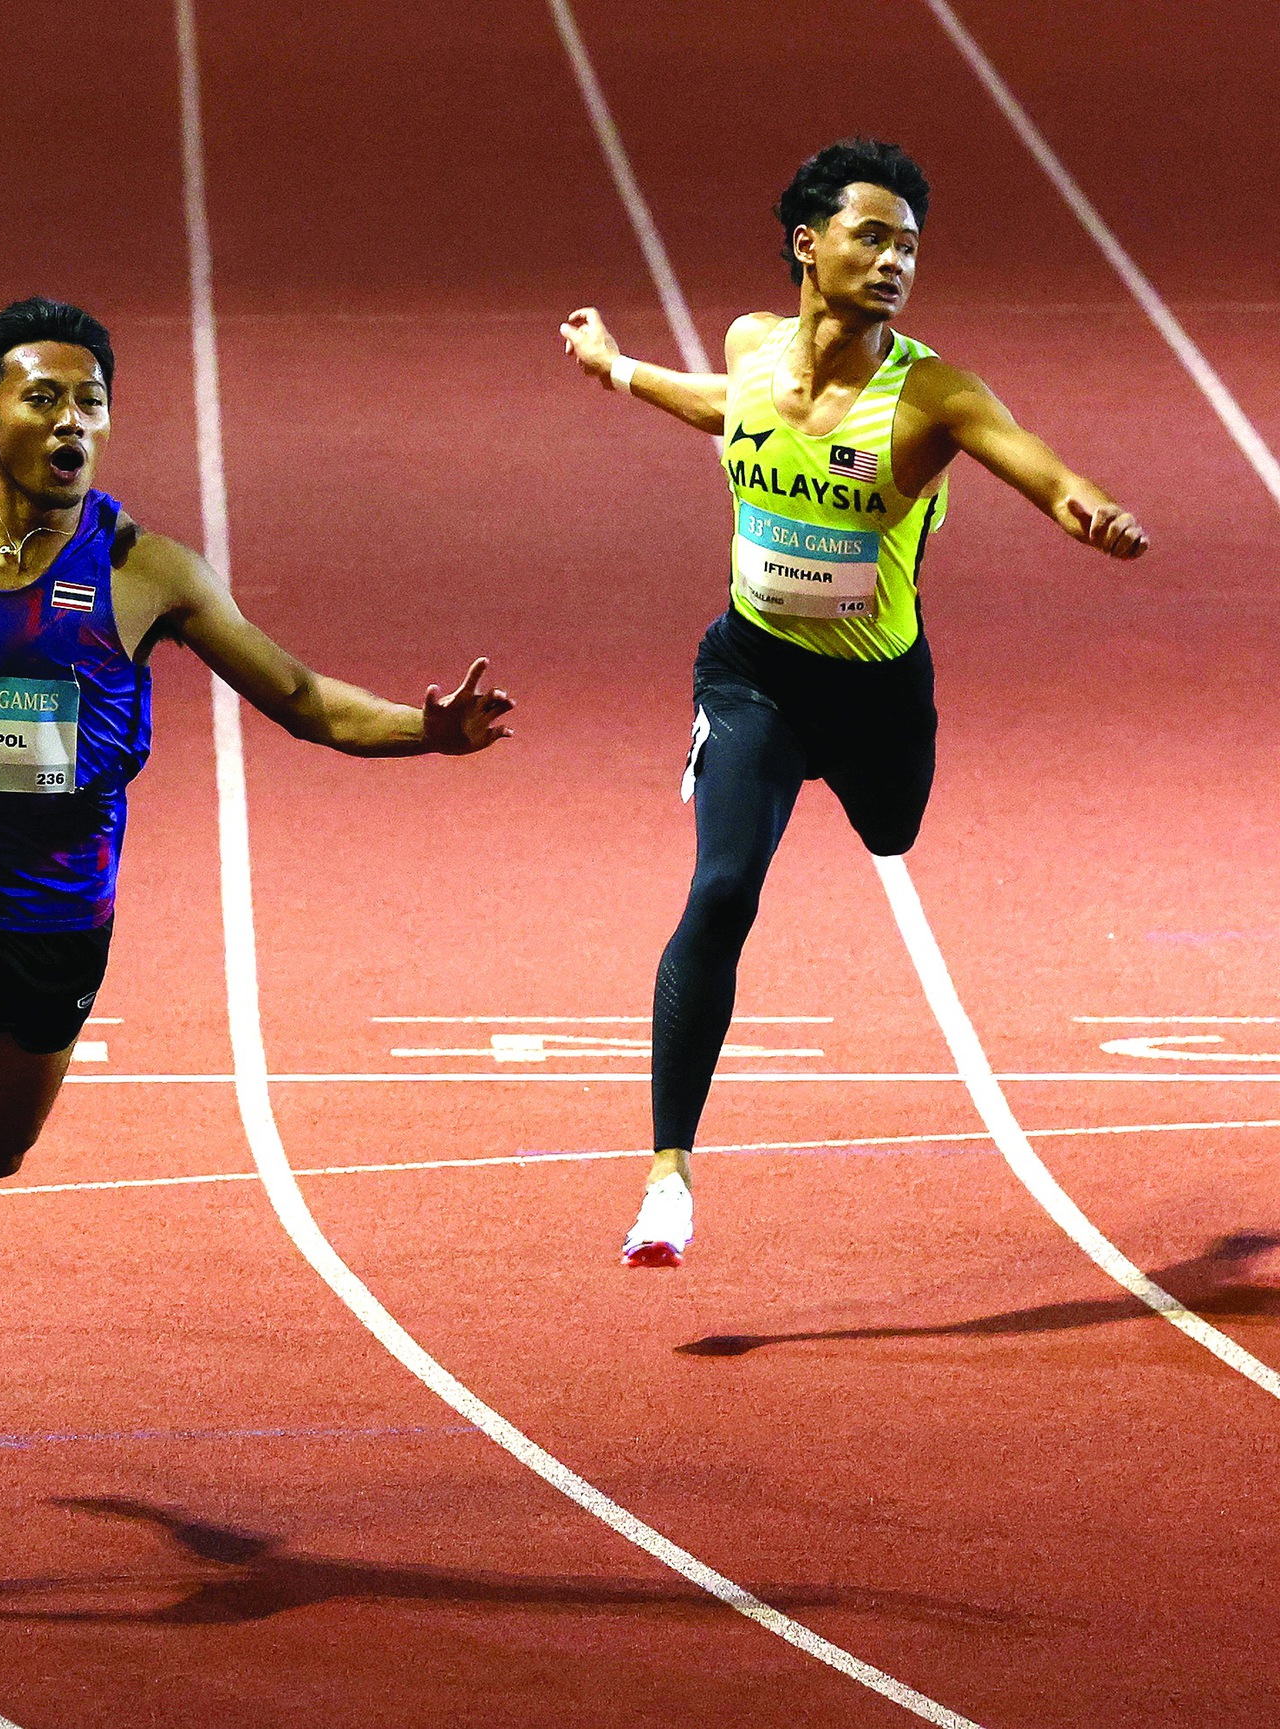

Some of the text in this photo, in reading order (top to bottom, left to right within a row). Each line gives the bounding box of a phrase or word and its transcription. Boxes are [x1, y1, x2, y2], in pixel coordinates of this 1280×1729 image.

[728, 460, 887, 513] MALAYSIA
[772, 526, 799, 548] SEA
[805, 535, 862, 554] GAMES
[763, 561, 833, 583] IFTIKHAR
[839, 602, 865, 612] 140
[36, 773, 65, 785] 236
